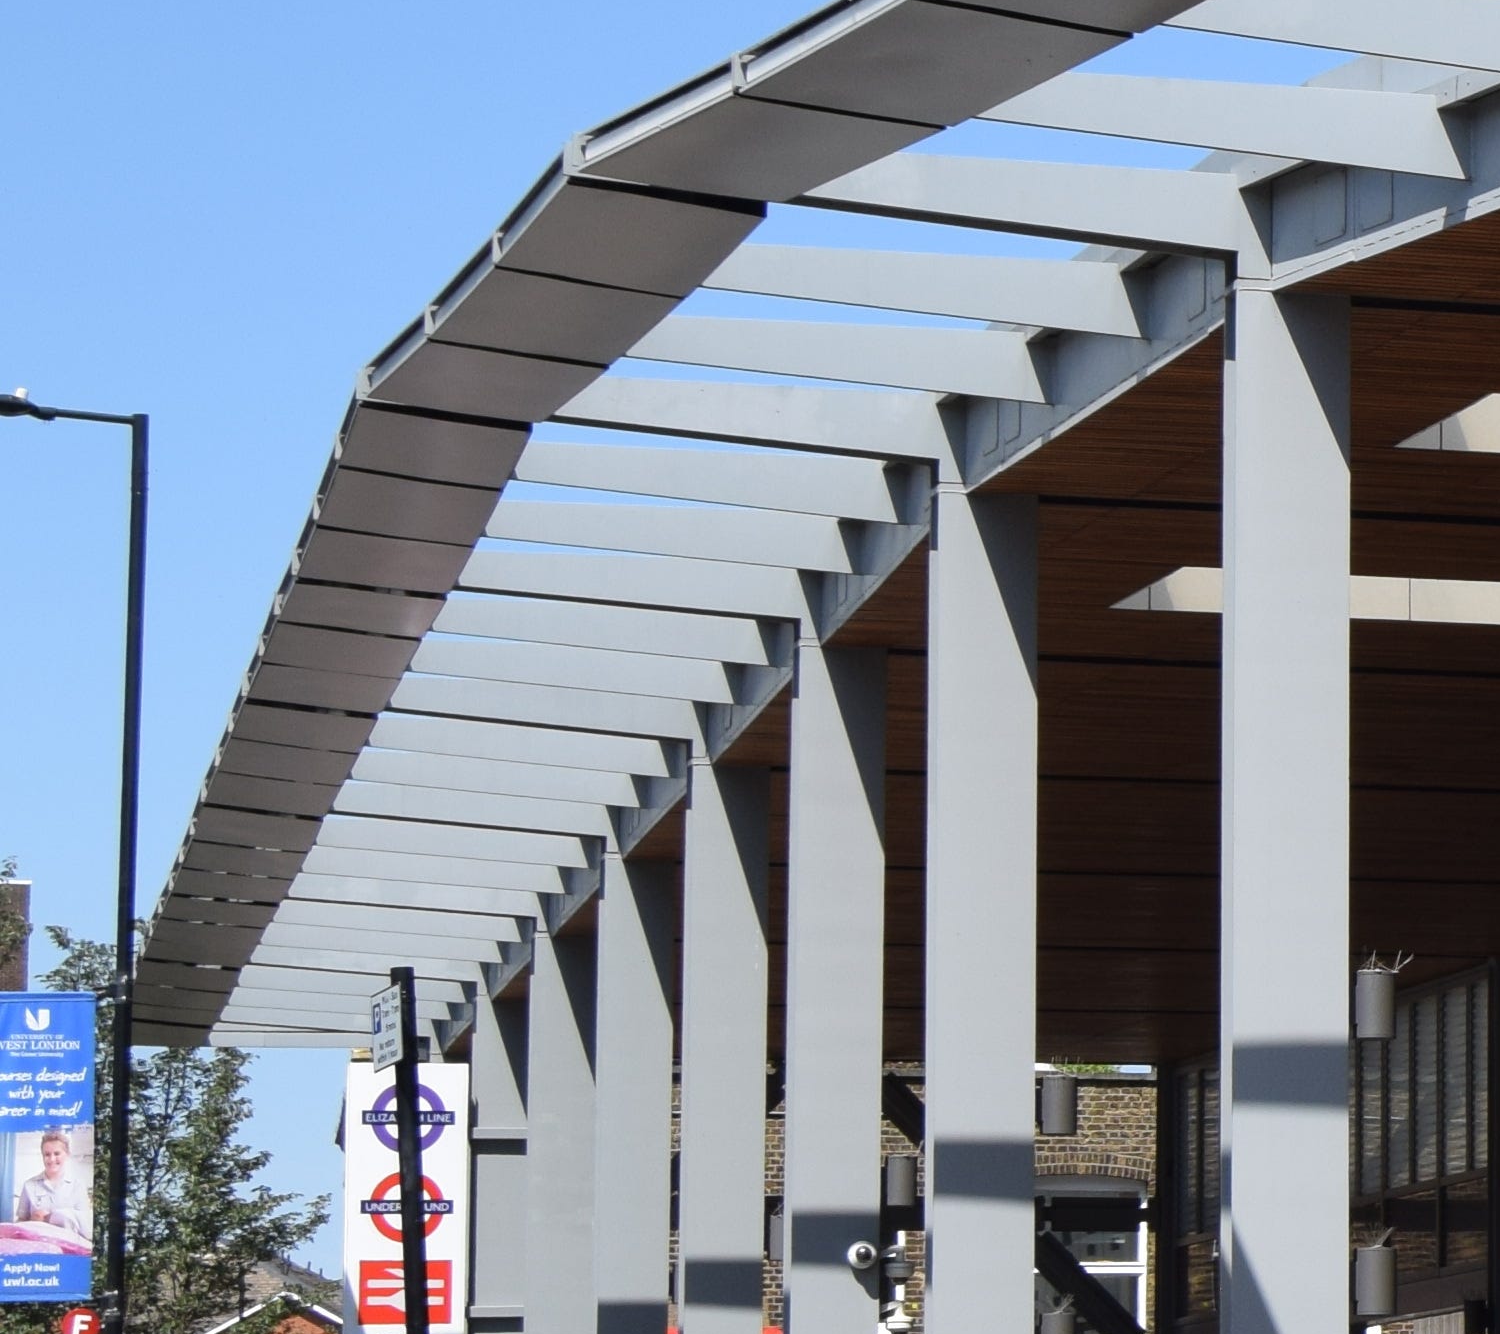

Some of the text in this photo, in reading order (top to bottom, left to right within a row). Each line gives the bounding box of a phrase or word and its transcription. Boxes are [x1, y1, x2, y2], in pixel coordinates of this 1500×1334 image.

[32, 1040, 80, 1050] LONDON
[0, 1067, 87, 1086] ourses designed
[9, 1085, 65, 1104] with your
[0, 1107, 31, 1116] areer
[34, 1105, 45, 1116] in
[365, 1113, 451, 1123] ELIZA LINE
[365, 1202, 450, 1212] UNDERUND
[3, 1263, 60, 1274] Apply Now!
[3, 1276, 60, 1287] uwl.ac.uk
